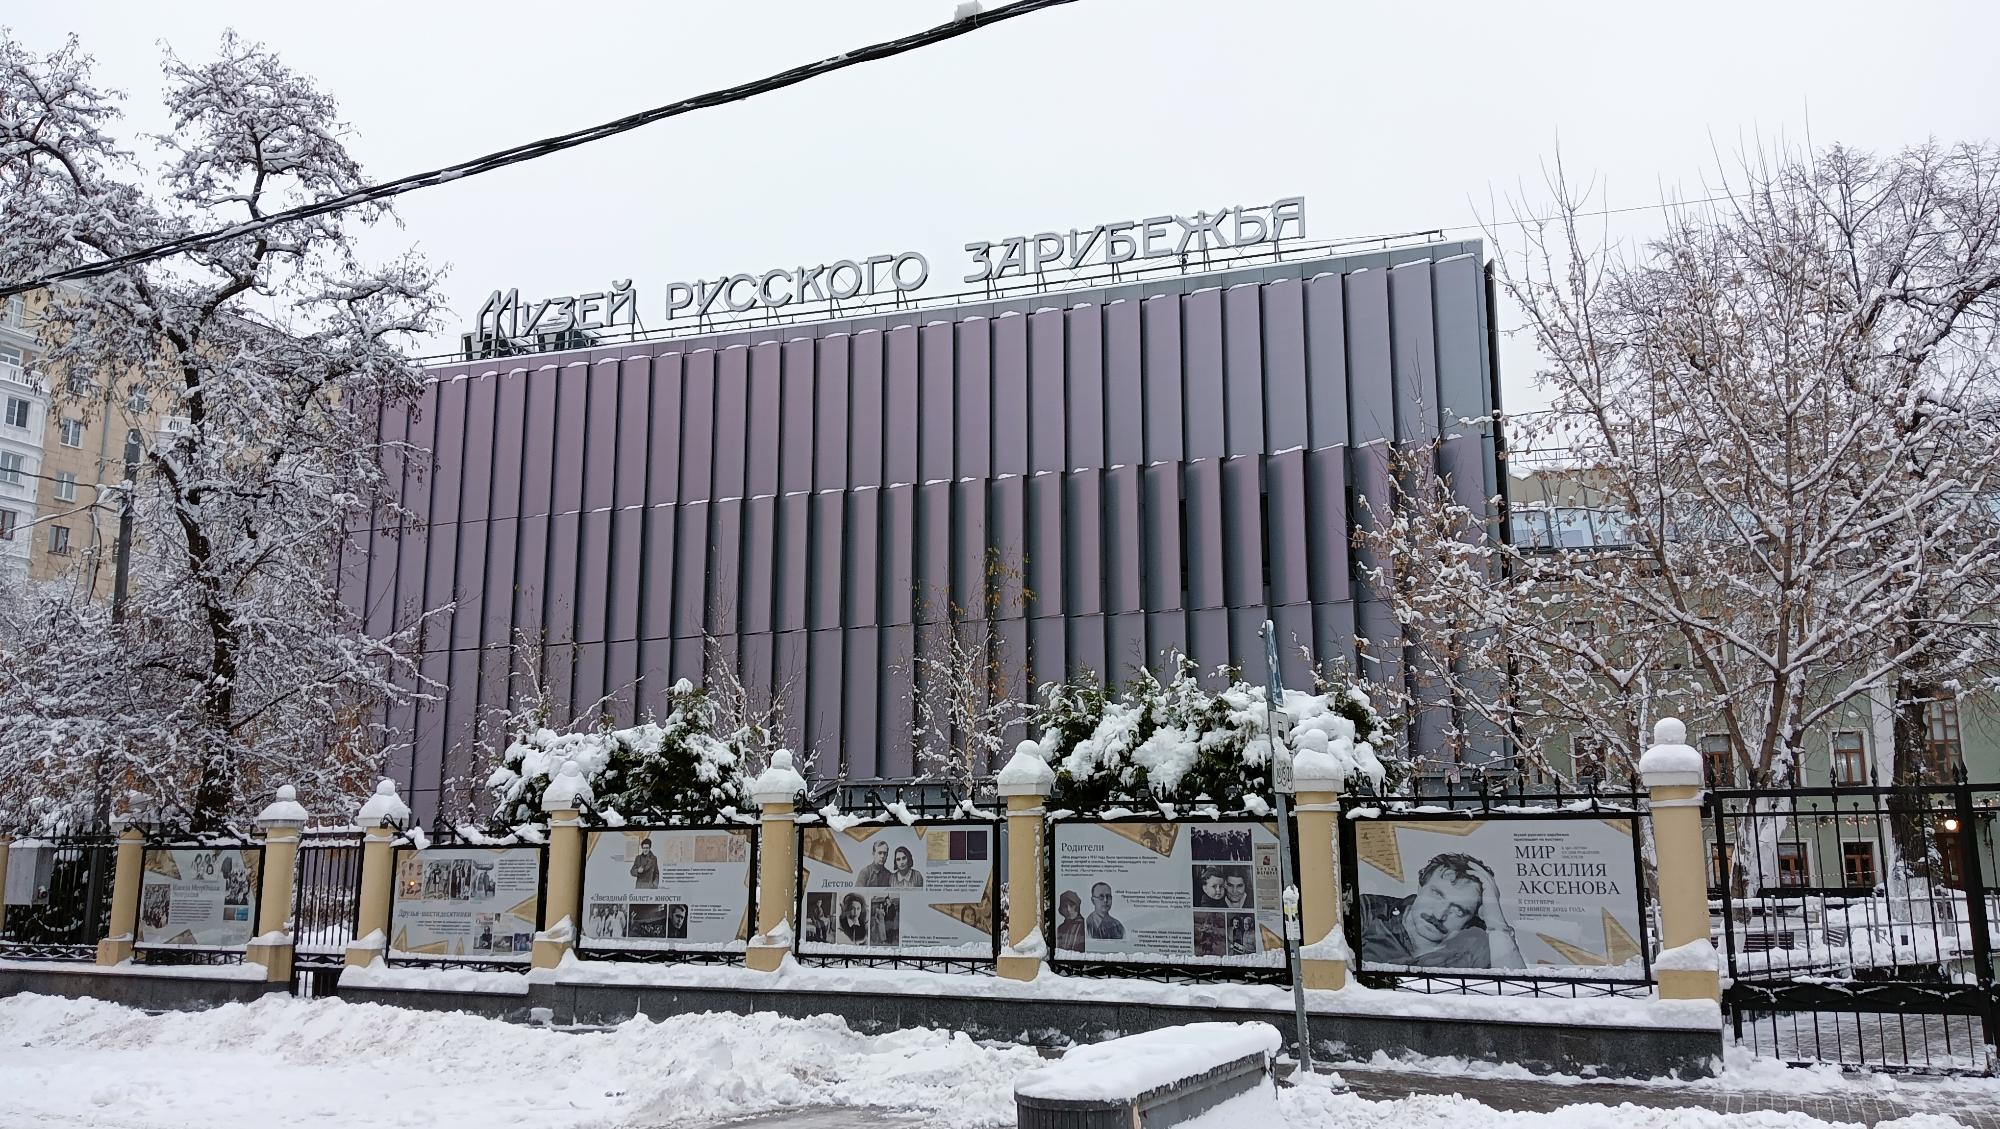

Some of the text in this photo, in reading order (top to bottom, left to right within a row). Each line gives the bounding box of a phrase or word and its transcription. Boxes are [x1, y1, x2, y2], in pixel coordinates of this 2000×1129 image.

[666, 251, 928, 321] РУССКОГО
[964, 196, 1305, 283] ЗАРУБЕЖЬЯ
[1061, 842, 1105, 853] Родители
[1514, 845, 1556, 859] МИР
[1516, 863, 1608, 877] ВАСИЛИЯ
[821, 878, 854, 889] Детство
[1517, 880, 1622, 895] АКСЕНОВА
[590, 893, 628, 903] «Звездный
[628, 893, 653, 902] билет»
